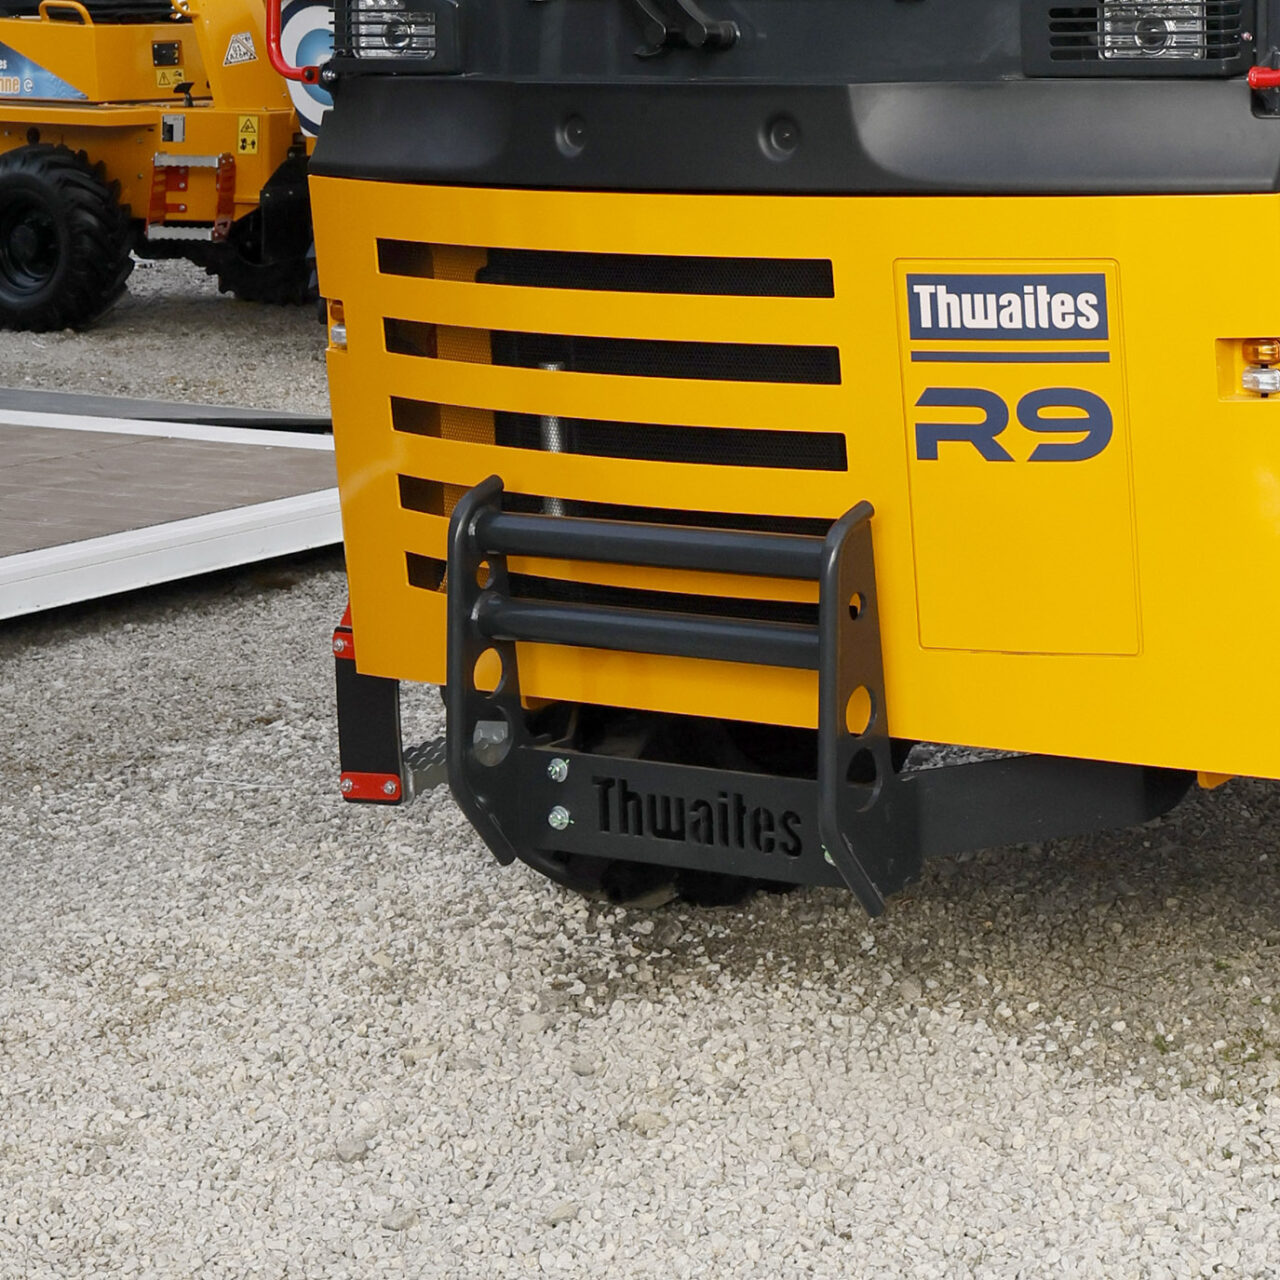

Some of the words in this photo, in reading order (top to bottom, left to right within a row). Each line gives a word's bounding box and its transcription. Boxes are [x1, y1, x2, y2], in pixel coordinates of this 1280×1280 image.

[913, 285, 1100, 330] Thwaites
[914, 387, 1114, 463] R9
[591, 775, 802, 859] Thwaites
